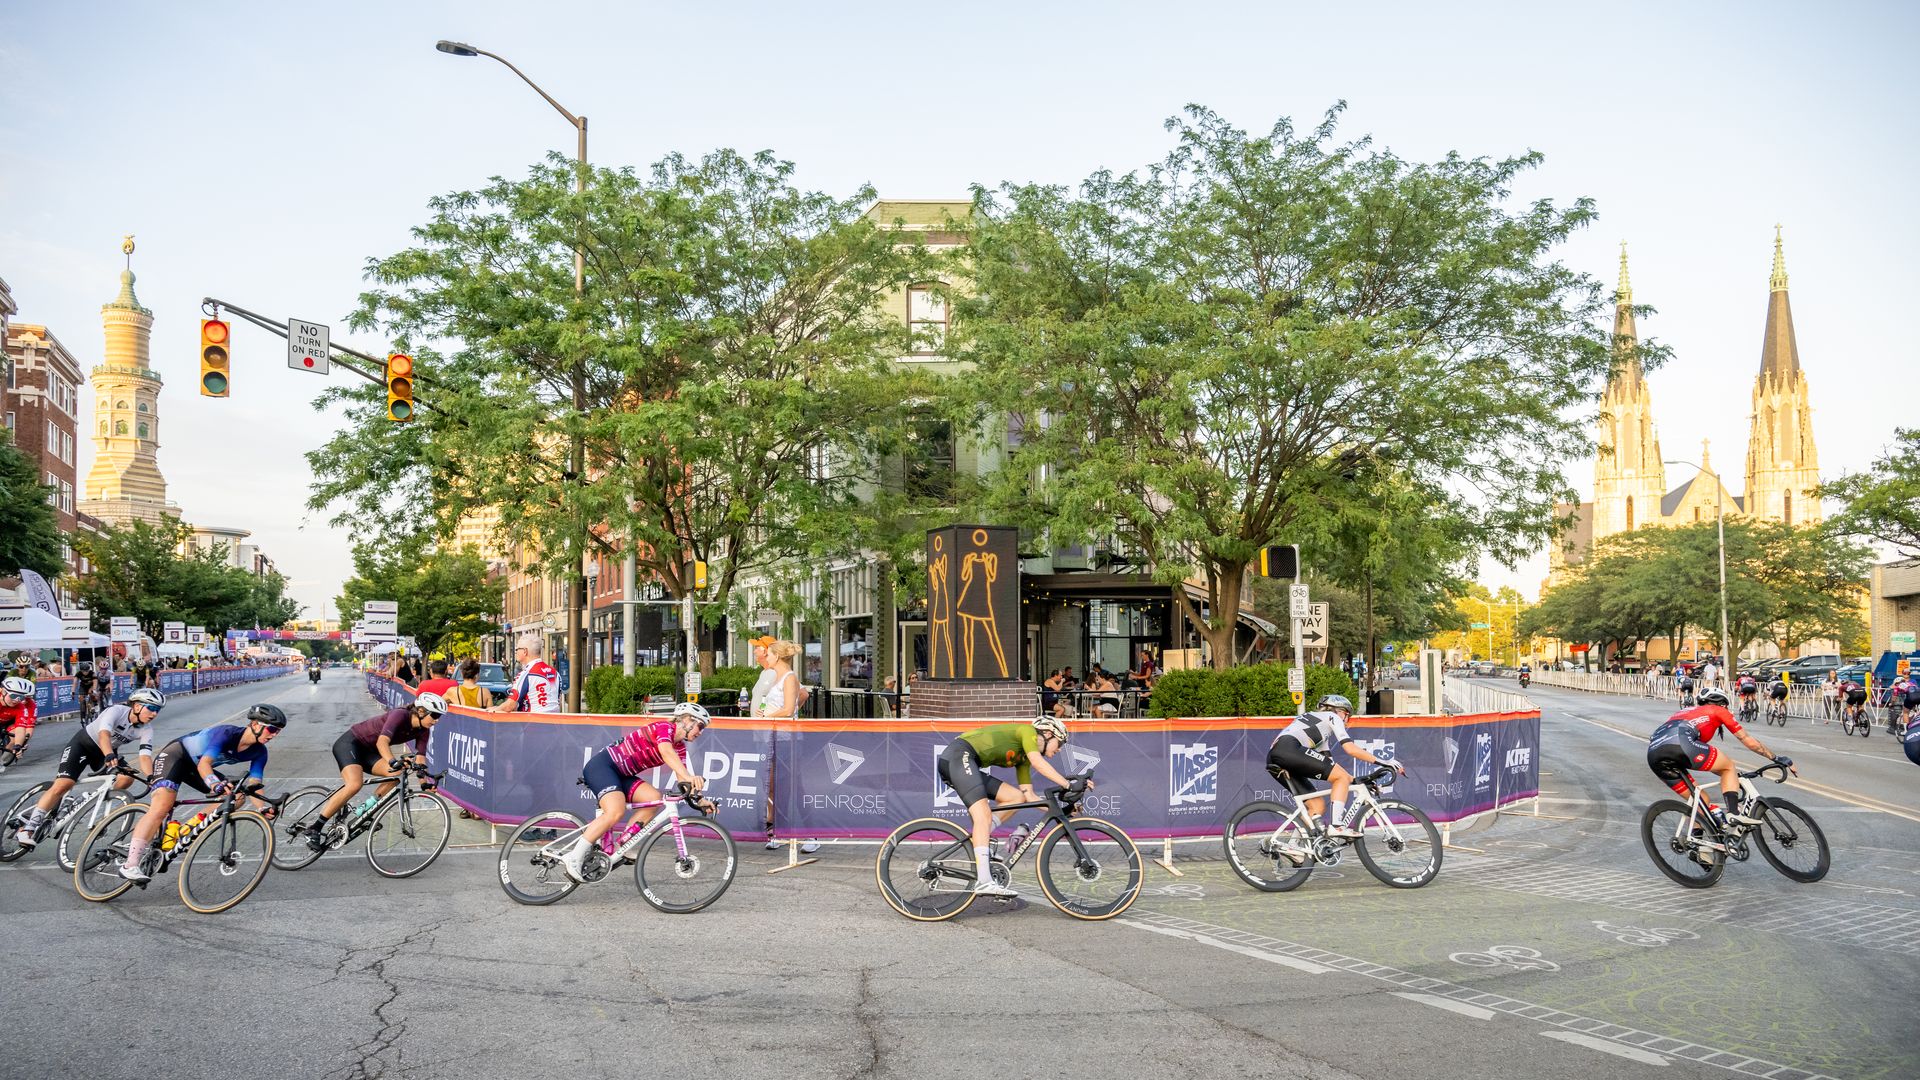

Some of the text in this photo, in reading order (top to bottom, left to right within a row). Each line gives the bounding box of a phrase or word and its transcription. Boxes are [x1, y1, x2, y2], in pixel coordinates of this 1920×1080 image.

[301, 325, 317, 336] NO
[298, 336, 320, 347] TURN
[292, 345, 325, 358] ON RED
[1505, 748, 1530, 768] KITE
[1172, 749, 1217, 797] MASS
[1181, 770, 1217, 795] AVE
[726, 798, 755, 809] TAPE
[803, 795, 886, 812] PENROSE
[1254, 790, 1296, 804] PENR
[617, 819, 657, 856] cannondale
[1009, 821, 1046, 865] cannondale
